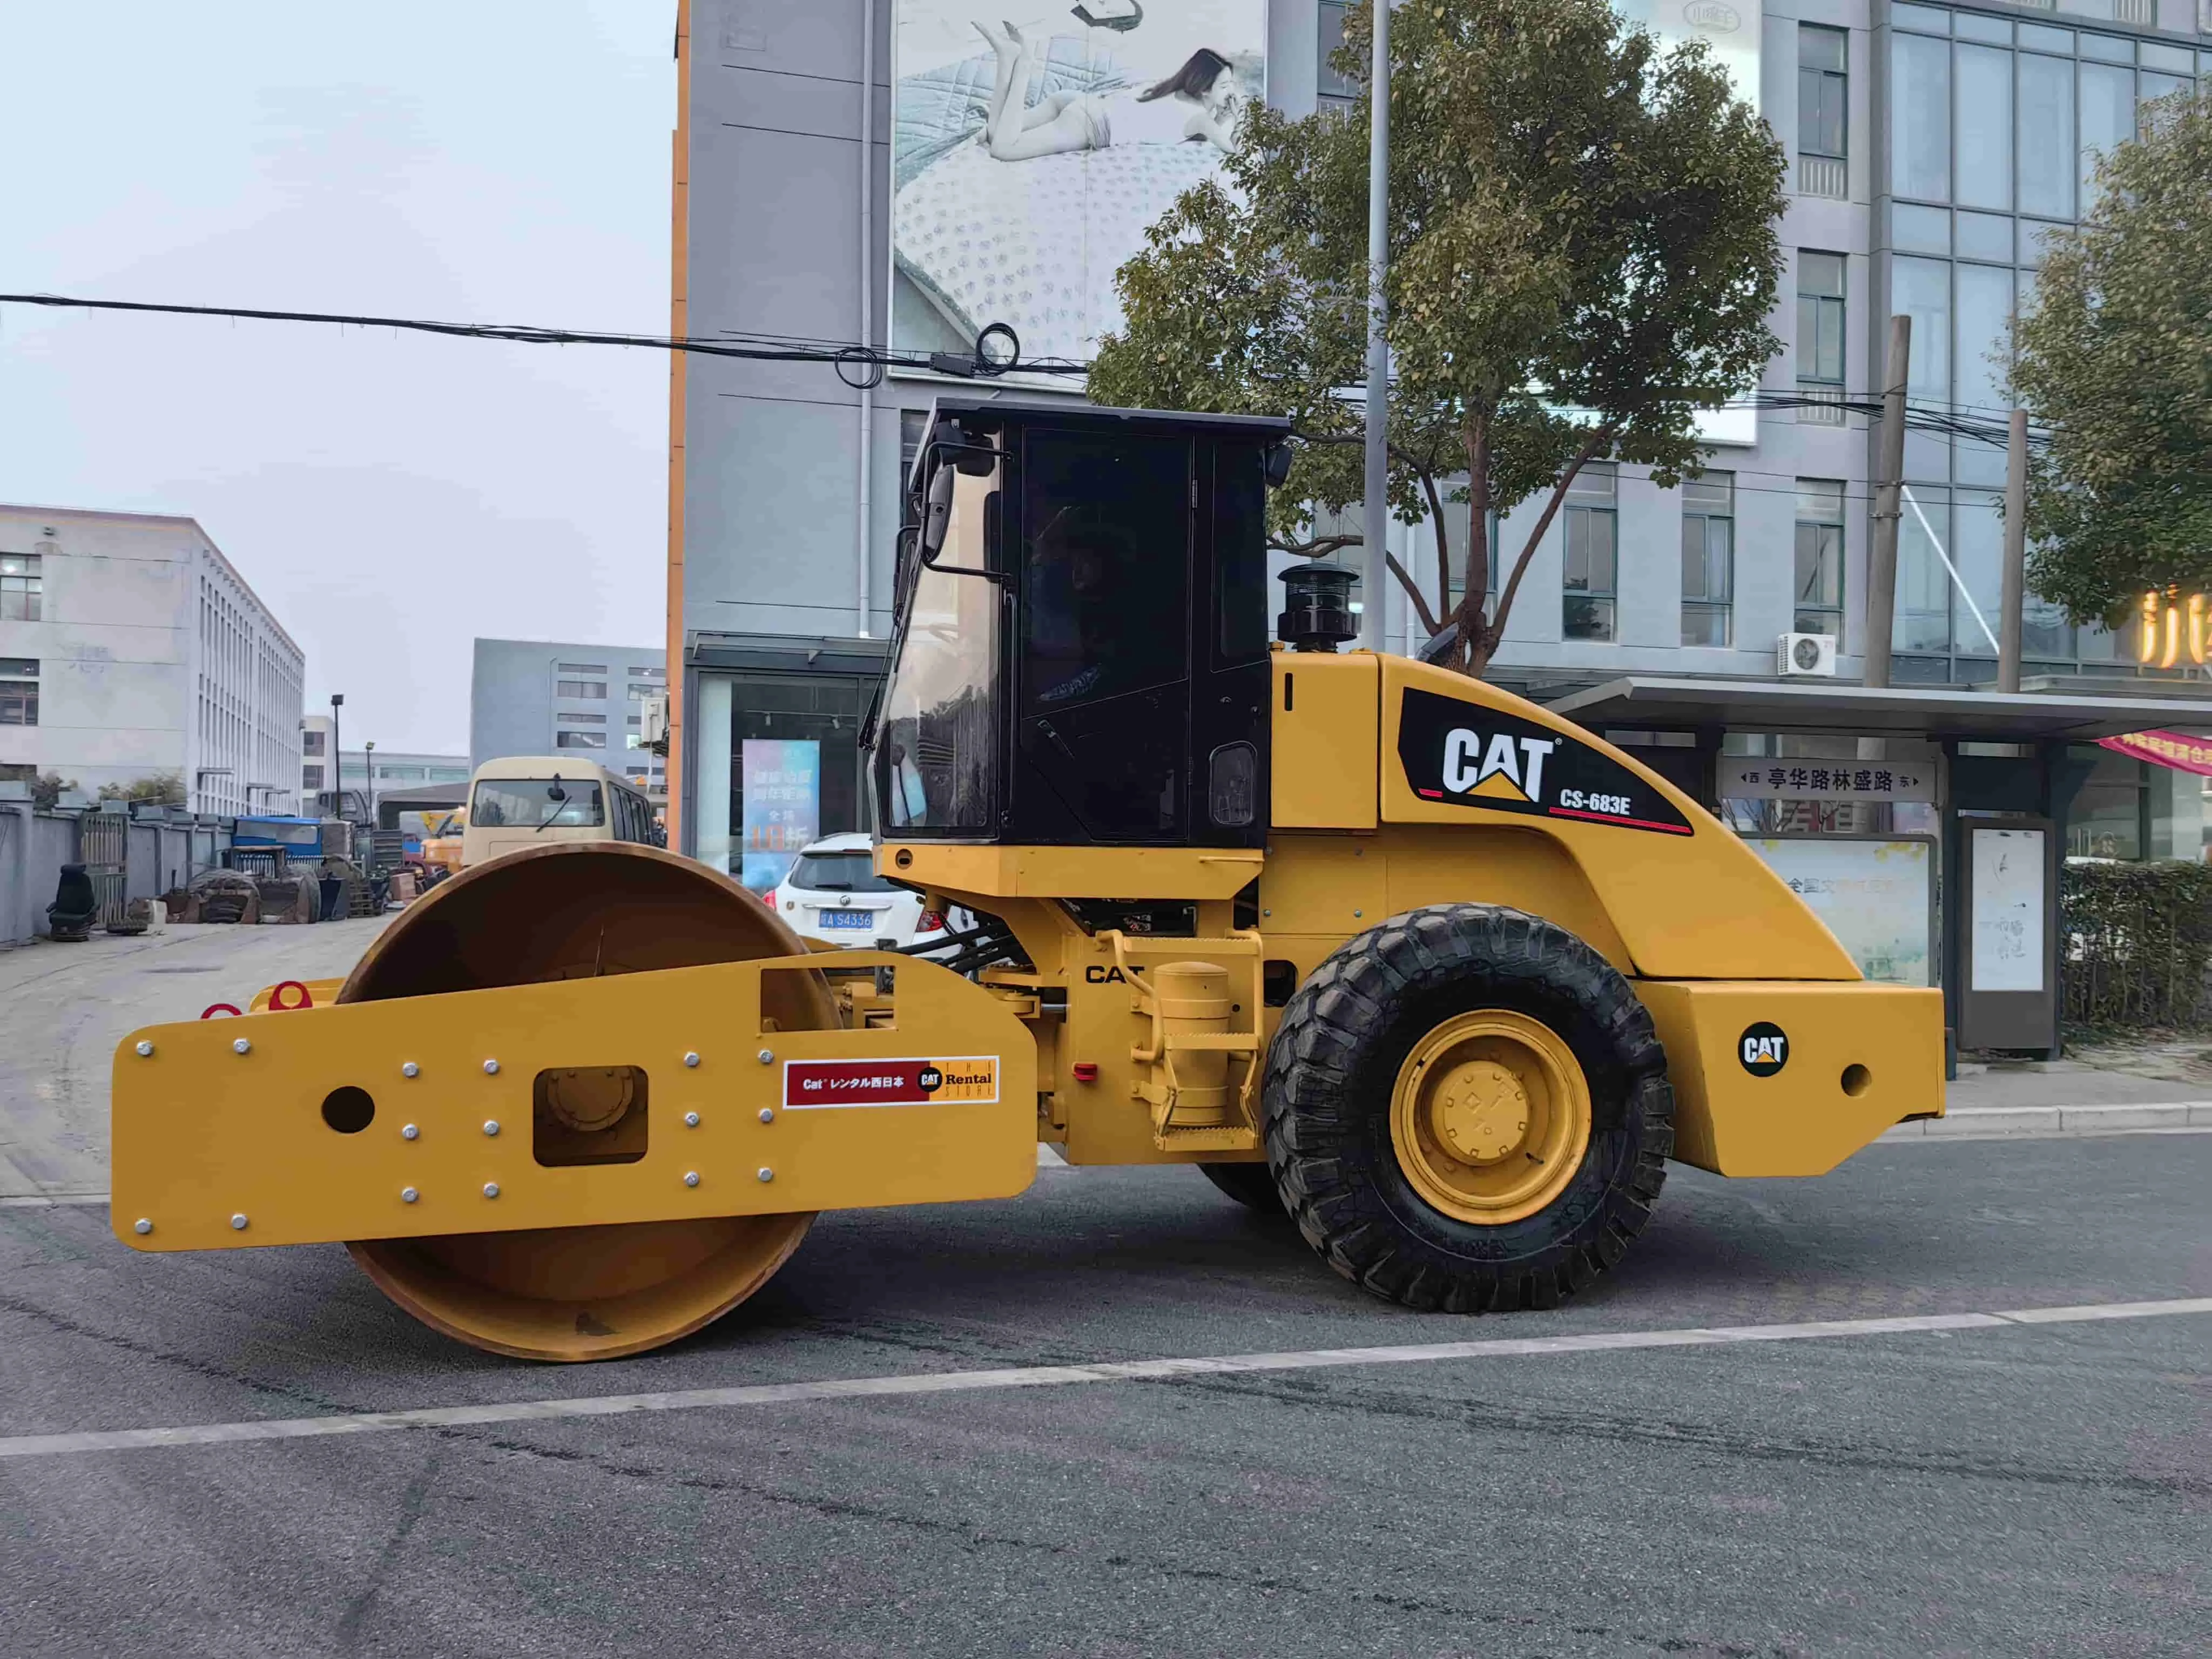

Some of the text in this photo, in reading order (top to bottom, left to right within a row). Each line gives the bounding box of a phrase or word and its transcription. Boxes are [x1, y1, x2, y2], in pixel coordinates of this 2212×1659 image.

[1442, 729, 1554, 802] CAT
[1749, 767, 1910, 792] 西 亭华路林盛路 东
[1560, 788, 1631, 815] CS-683E
[1744, 1036, 1784, 1063] CAT
[803, 1076, 904, 1090] Cat レンタル西日本
[921, 1073, 992, 1085] CAT Rental
